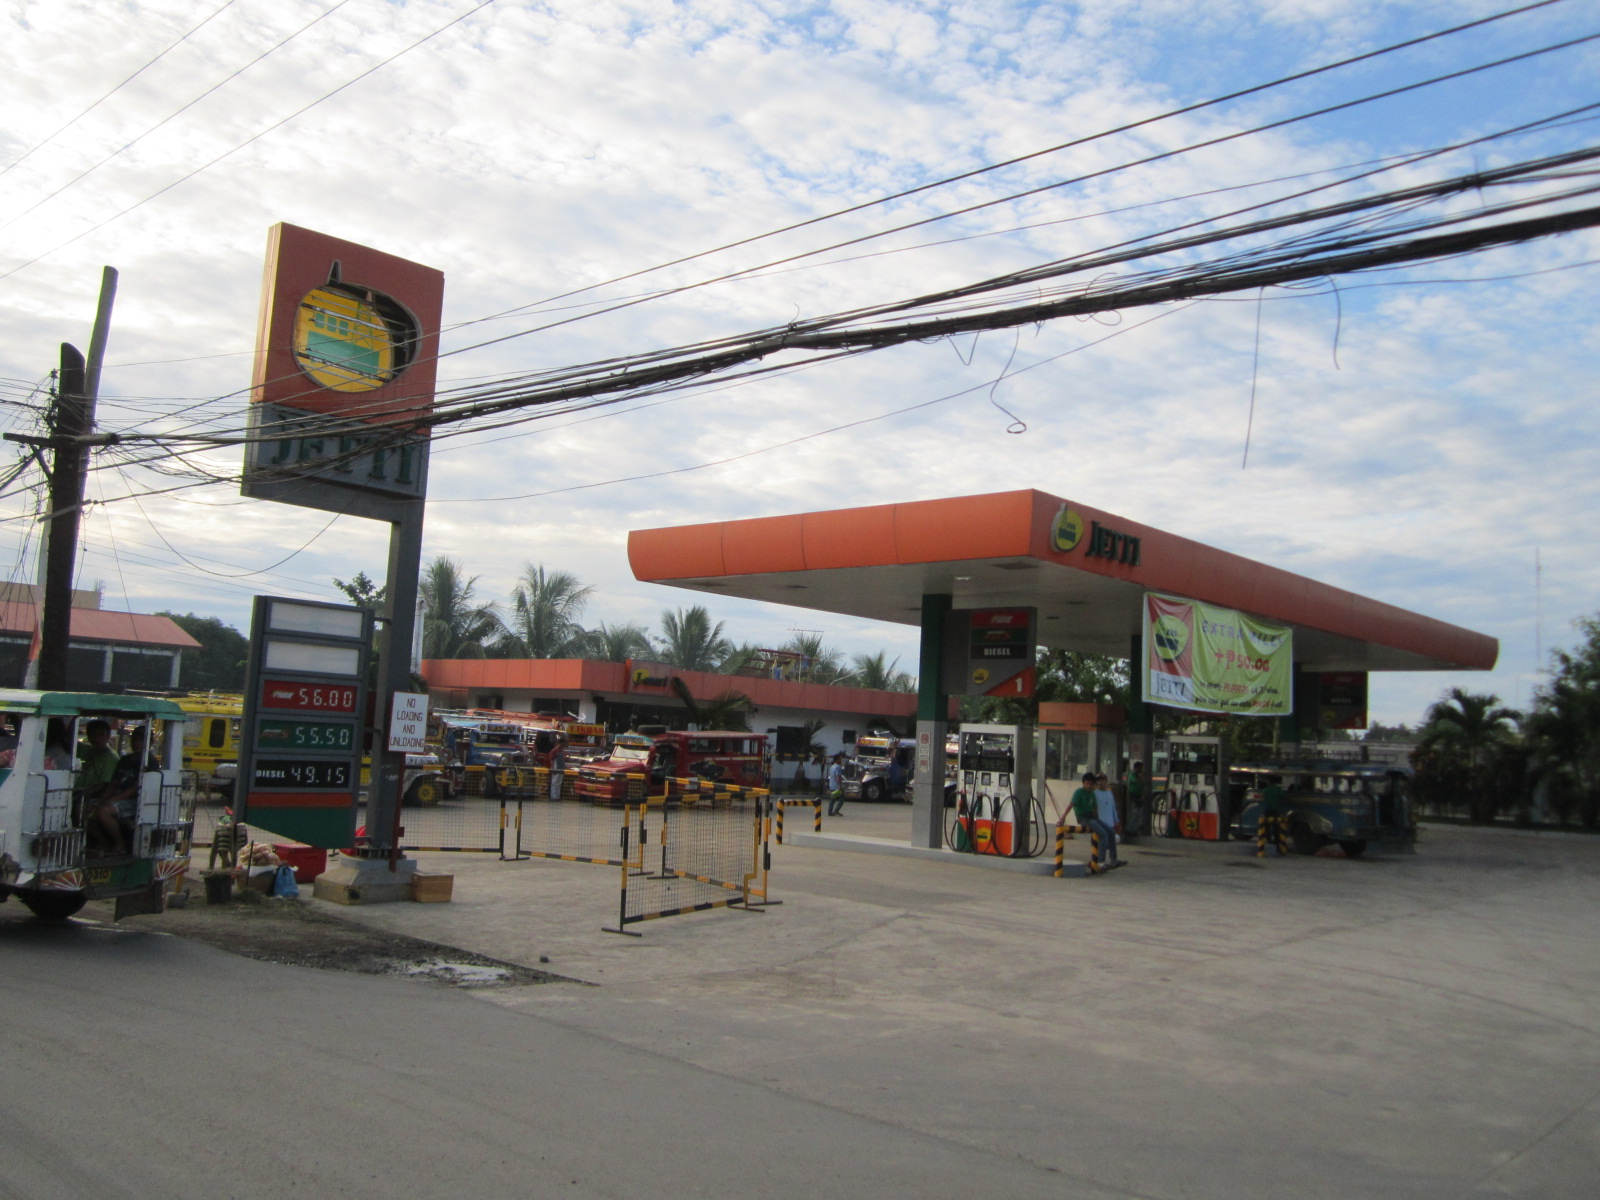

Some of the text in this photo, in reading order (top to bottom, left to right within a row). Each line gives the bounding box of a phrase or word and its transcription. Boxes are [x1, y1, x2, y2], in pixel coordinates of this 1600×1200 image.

[1085, 520, 1141, 566] JETTI
[984, 647, 1011, 656] DIESEL
[1015, 677, 1023, 693] 1
[299, 688, 352, 708] 56.00
[406, 698, 416, 708] NO
[396, 710, 424, 722] LOADING
[296, 727, 349, 745] 55.50
[402, 724, 416, 734] AND
[390, 737, 425, 748] UNLOADING
[255, 766, 345, 784] DIESEL 49.15
